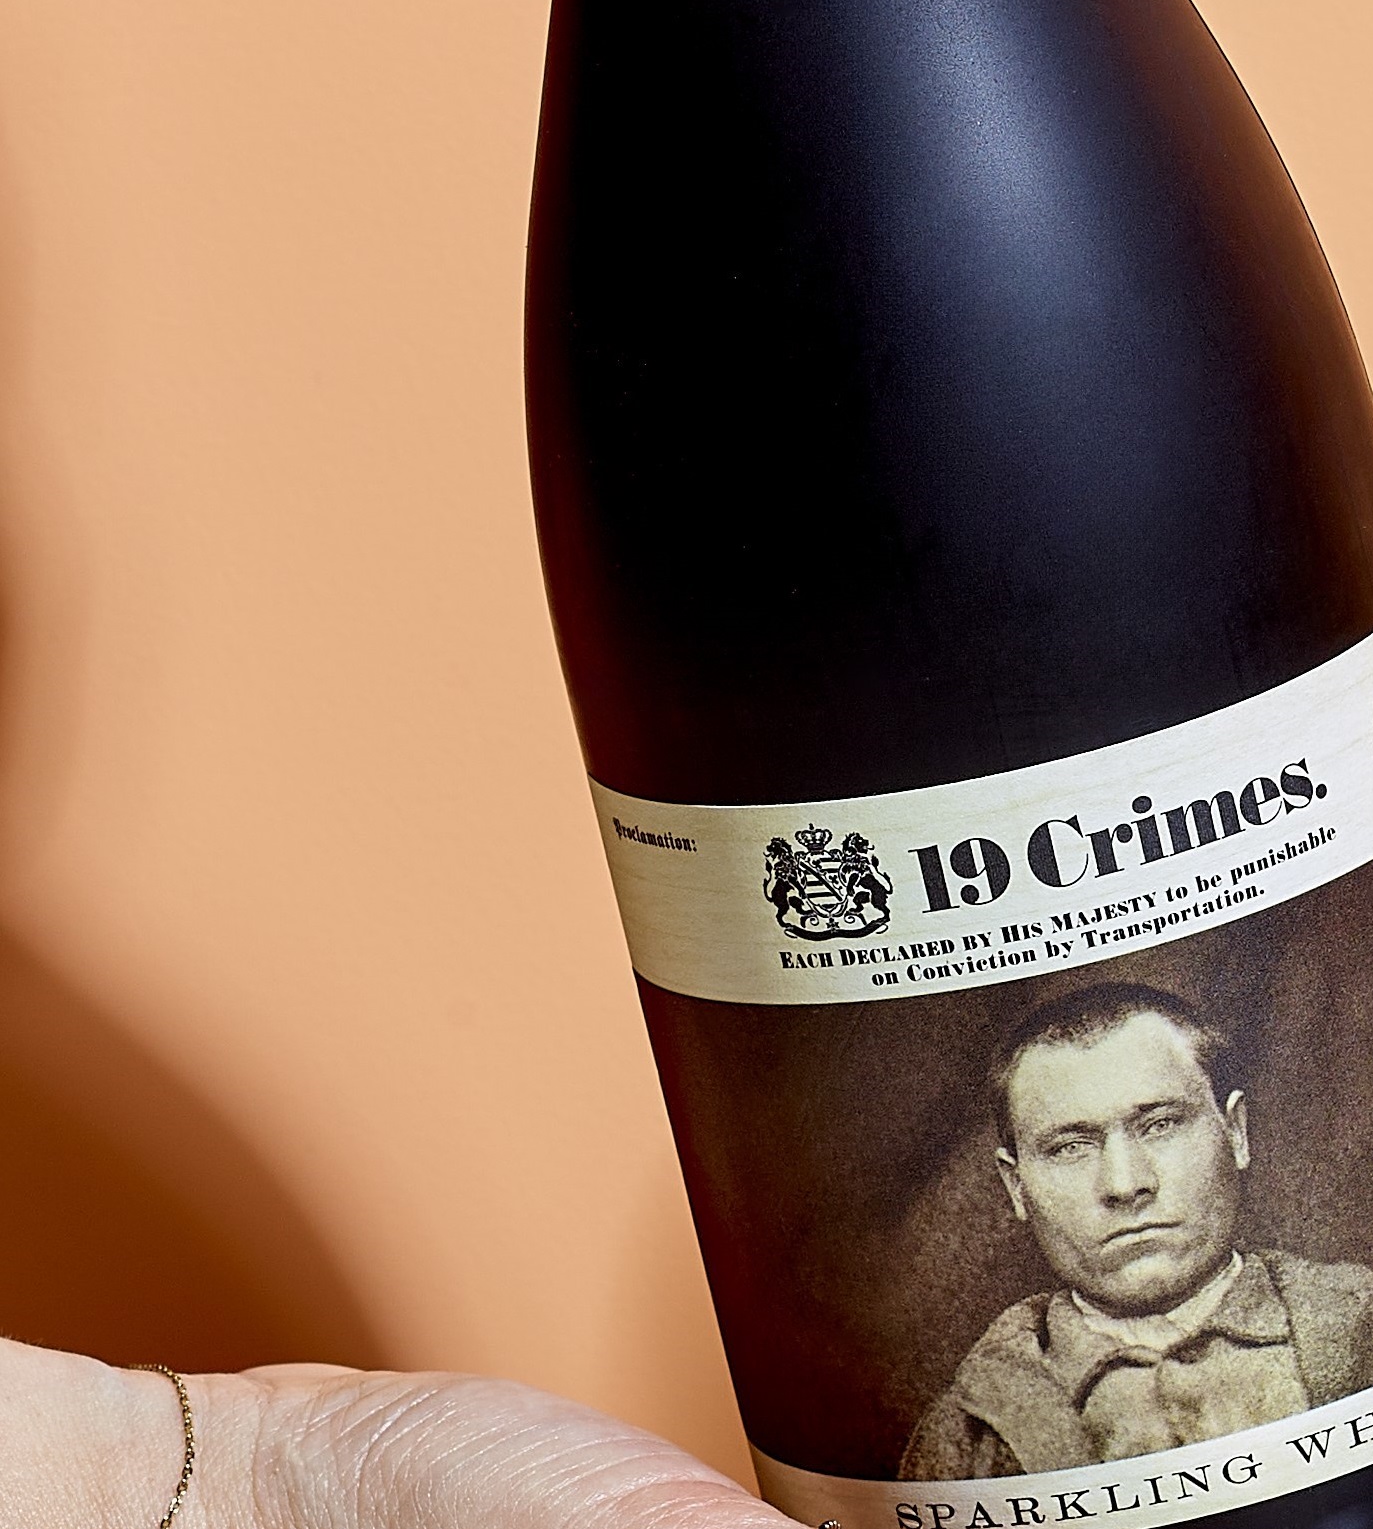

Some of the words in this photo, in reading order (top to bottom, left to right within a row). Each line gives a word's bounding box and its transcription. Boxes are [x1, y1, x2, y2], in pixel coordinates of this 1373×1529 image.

[612, 816, 698, 853] Proclamation:
[907, 837, 1011, 914] 19
[1027, 757, 1328, 888] Crimes.
[779, 950, 834, 970] EACH
[839, 939, 956, 967] DECLARED
[962, 931, 993, 952] BY
[1001, 921, 1044, 945] HIS
[1049, 891, 1158, 935] MAJESTY
[1165, 884, 1189, 903] to
[1195, 873, 1223, 894] be
[1230, 824, 1338, 886] punishable
[871, 971, 900, 987] on
[906, 946, 1038, 984] Conviction
[1044, 939, 1075, 959] by
[1081, 884, 1266, 950] Transportation.
